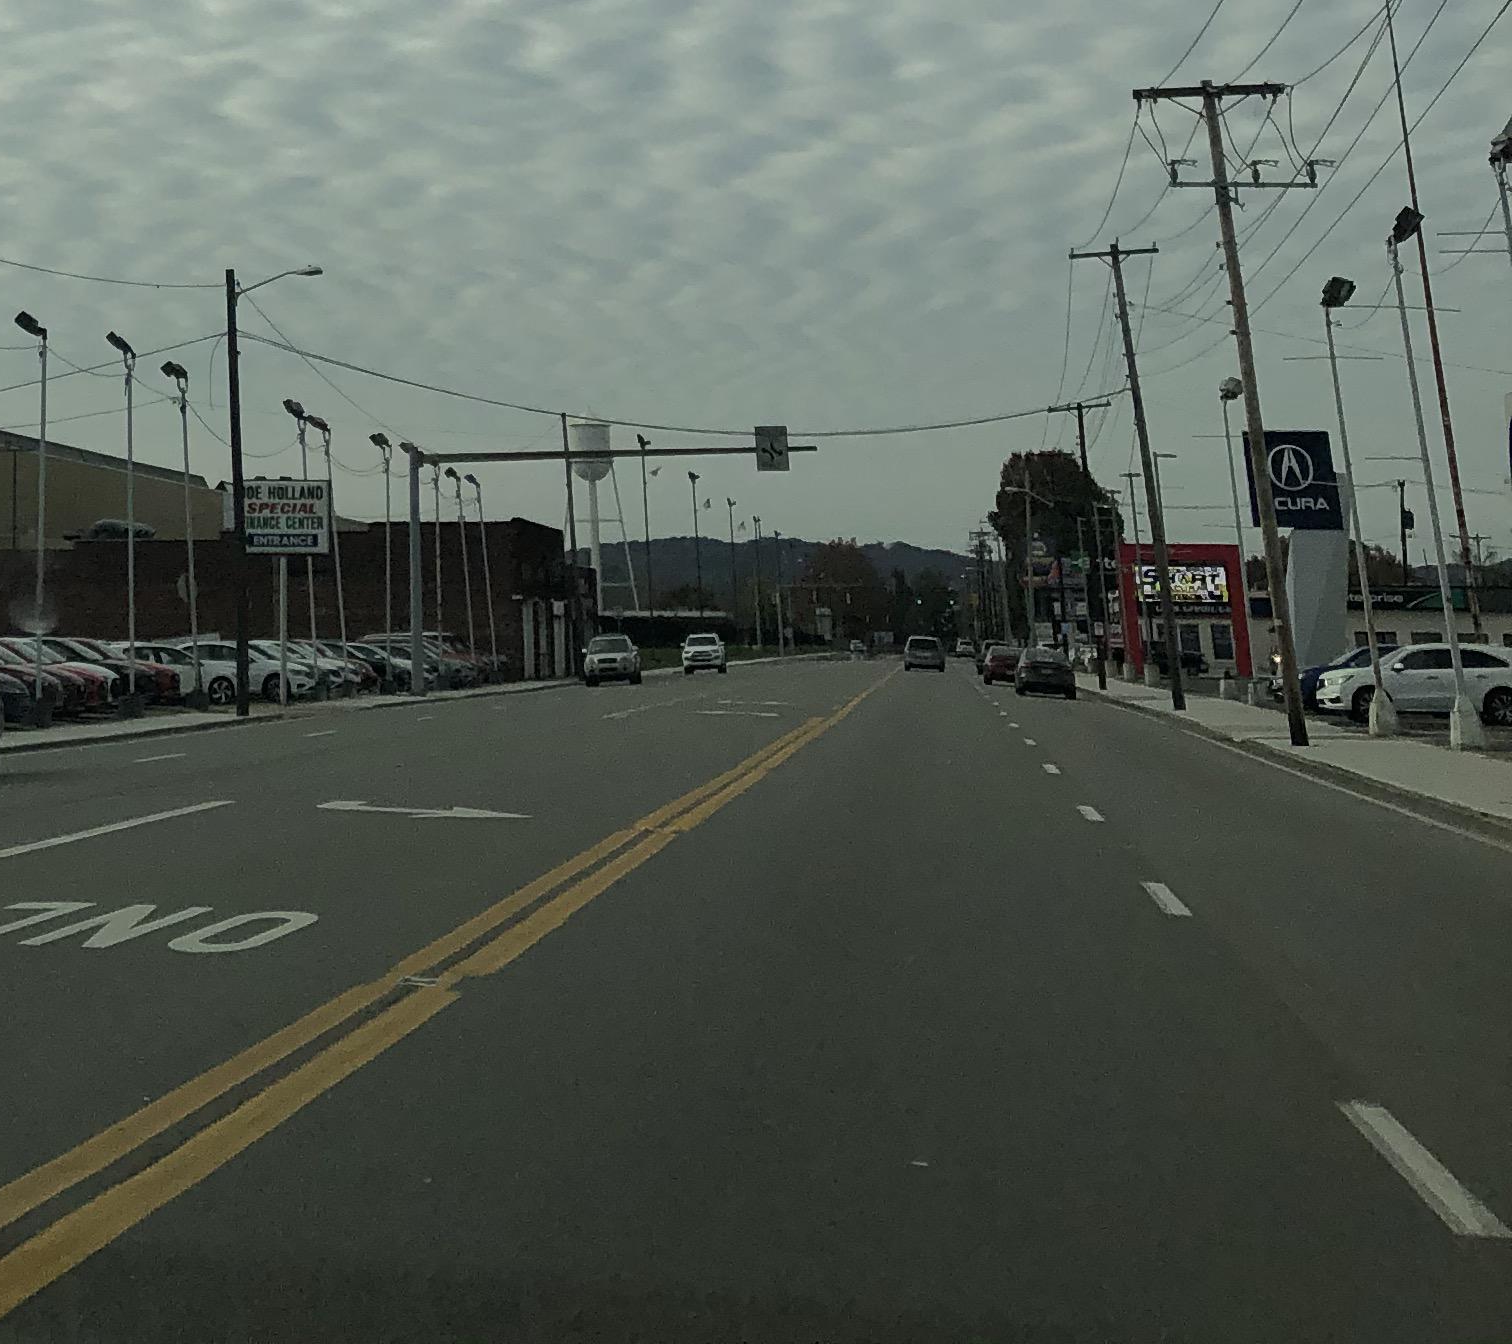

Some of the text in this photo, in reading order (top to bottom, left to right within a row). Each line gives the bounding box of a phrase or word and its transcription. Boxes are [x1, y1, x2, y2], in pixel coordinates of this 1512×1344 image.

[244, 485, 324, 501] OE HOLLAND
[246, 502, 317, 515] SPECIAL
[1274, 497, 1330, 510] CURA
[245, 515, 324, 530] INANCE CENTER
[253, 535, 314, 546] ENTRANCE
